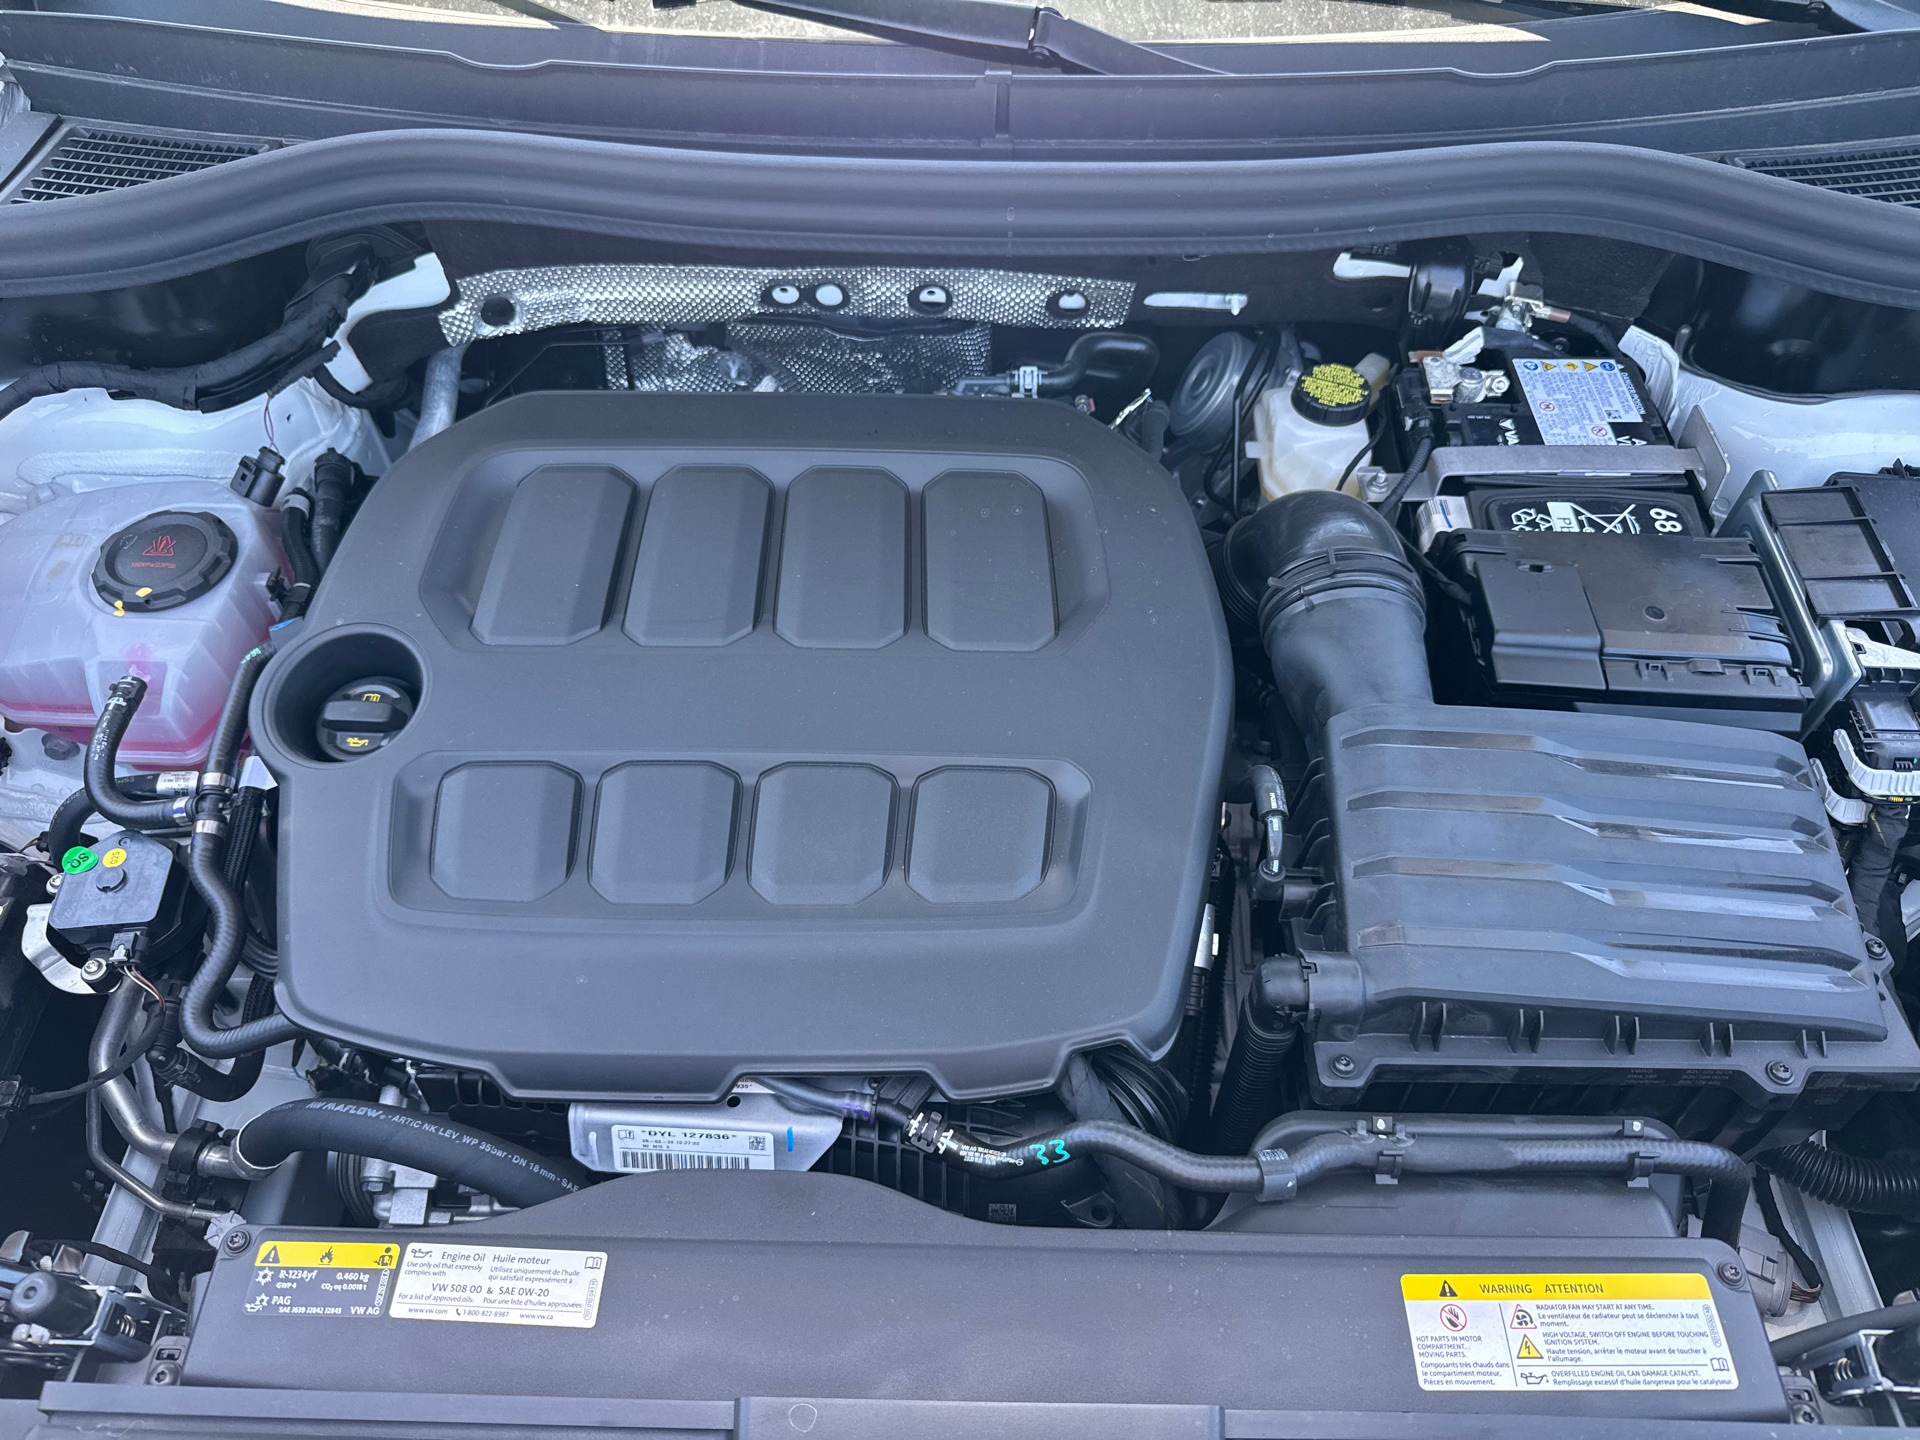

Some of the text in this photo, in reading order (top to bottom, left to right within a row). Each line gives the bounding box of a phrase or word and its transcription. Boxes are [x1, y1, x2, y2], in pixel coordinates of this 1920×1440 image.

[392, 1115, 421, 1128] ARTIC
[422, 1123, 438, 1133] NK
[512, 1155, 527, 1166] DN
[561, 1178, 579, 1192] SAE
[442, 1252, 486, 1262] Engine Oil
[493, 1254, 550, 1264] Huile moteur
[279, 1270, 318, 1281] R-1234yf
[359, 1272, 369, 1282] kg
[514, 1268, 551, 1276] uniquement
[432, 1283, 449, 1292] VW
[450, 1284, 468, 1293] 508
[470, 1285, 482, 1293] 00
[498, 1286, 550, 1297] SAE 0W-20
[1479, 1284, 1532, 1293] WARNING
[1545, 1284, 1604, 1293] ATTENTION
[271, 1296, 291, 1305] PAG
[350, 1306, 380, 1315] VW AG
